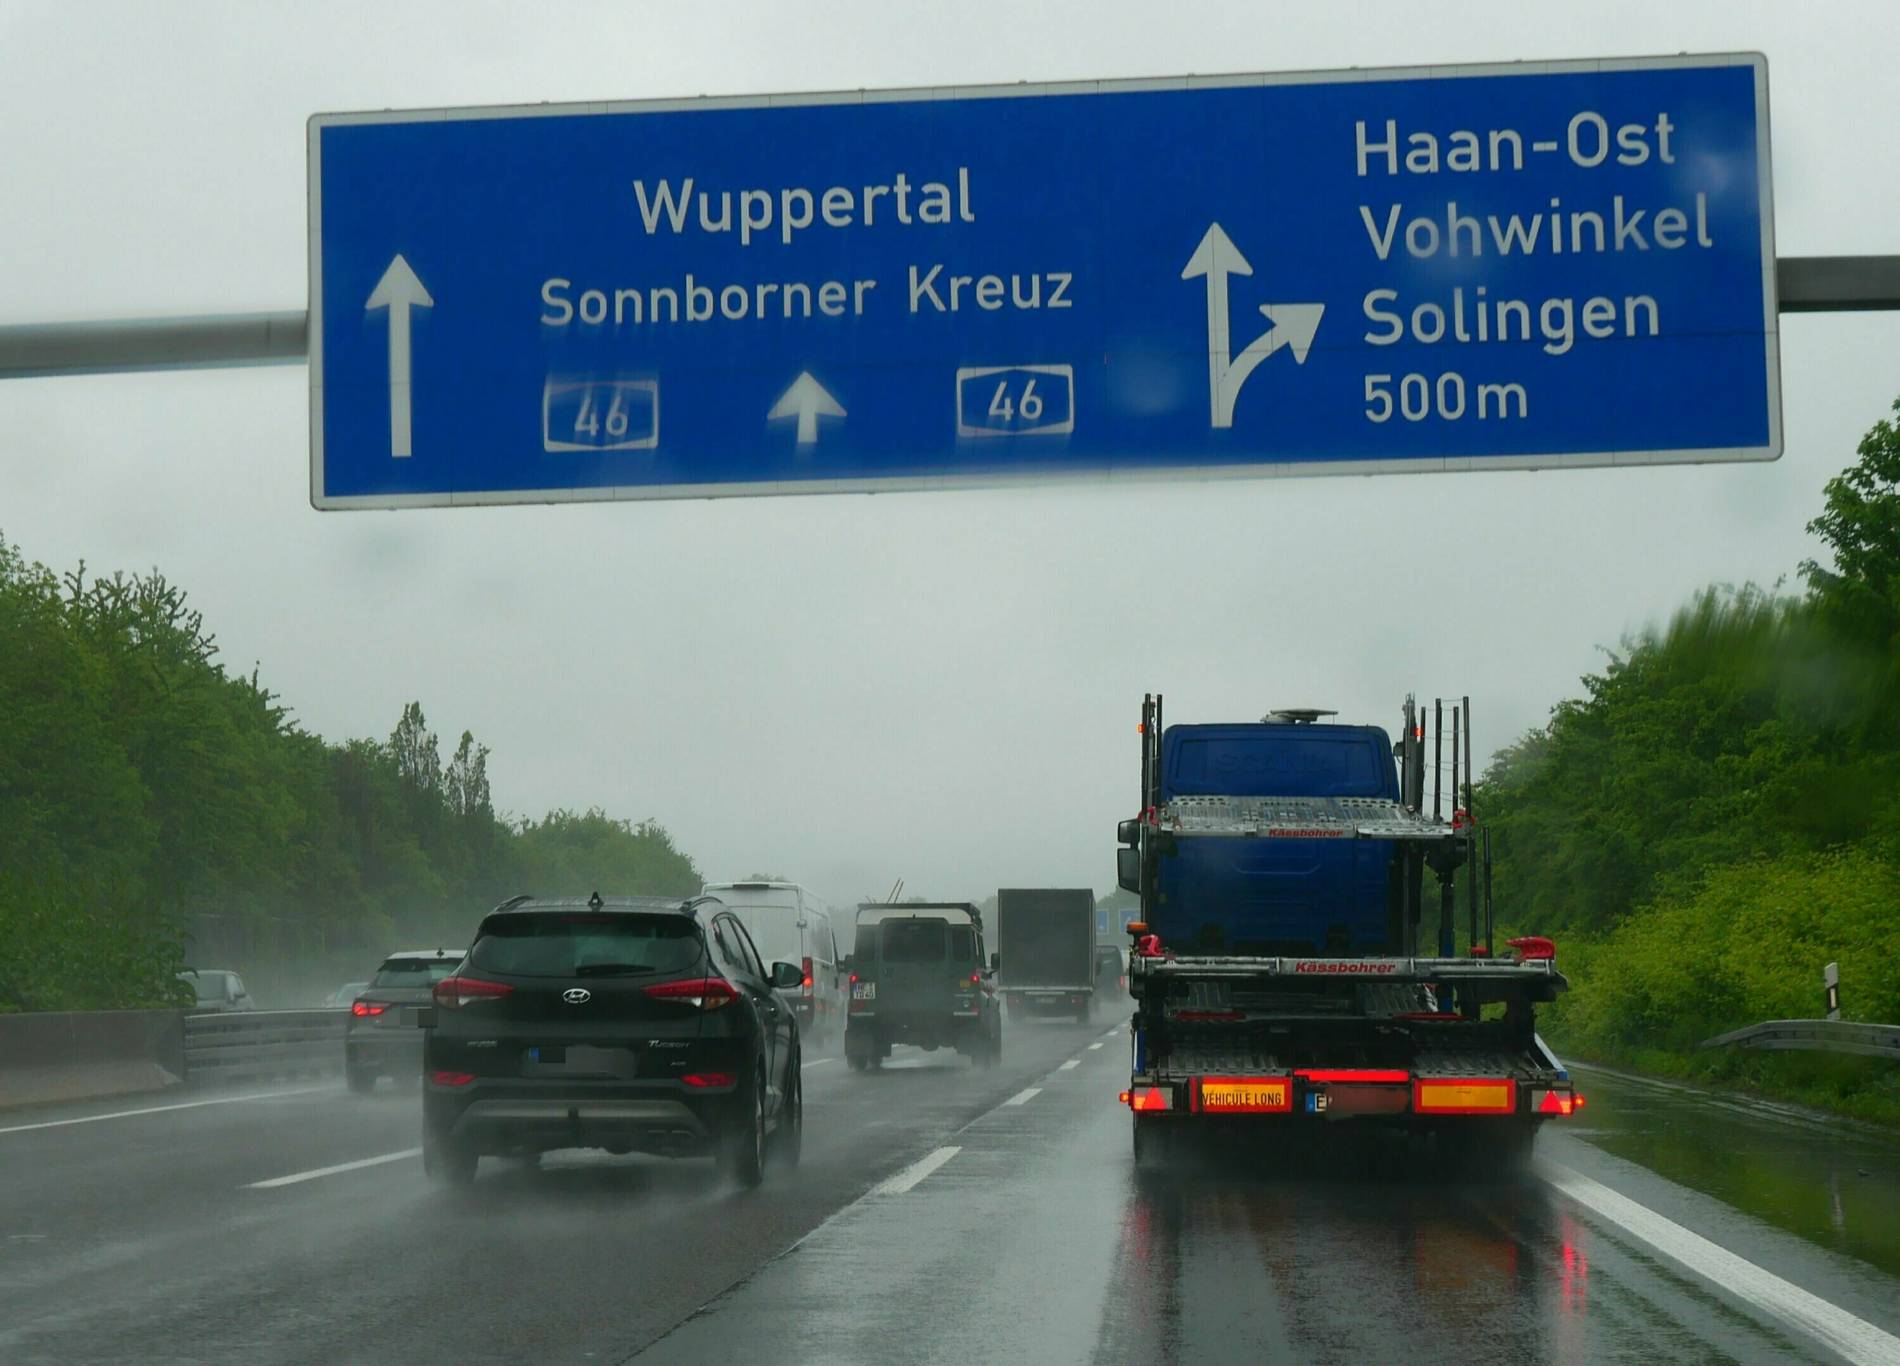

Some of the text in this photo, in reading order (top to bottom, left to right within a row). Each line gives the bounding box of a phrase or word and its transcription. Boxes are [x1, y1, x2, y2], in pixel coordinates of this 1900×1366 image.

[1355, 111, 1675, 177] Haan-Ost
[633, 167, 975, 246] Wuppertal
[1359, 193, 1713, 261] Vohwinkel
[540, 265, 1073, 327] Sonnborner Kreuz
[1363, 287, 1660, 356] Solingen
[573, 394, 630, 438] 46
[987, 378, 1044, 421] 46
[1295, 961, 1396, 974] Kässbohrer
[1255, 1092, 1282, 1105] LONG
